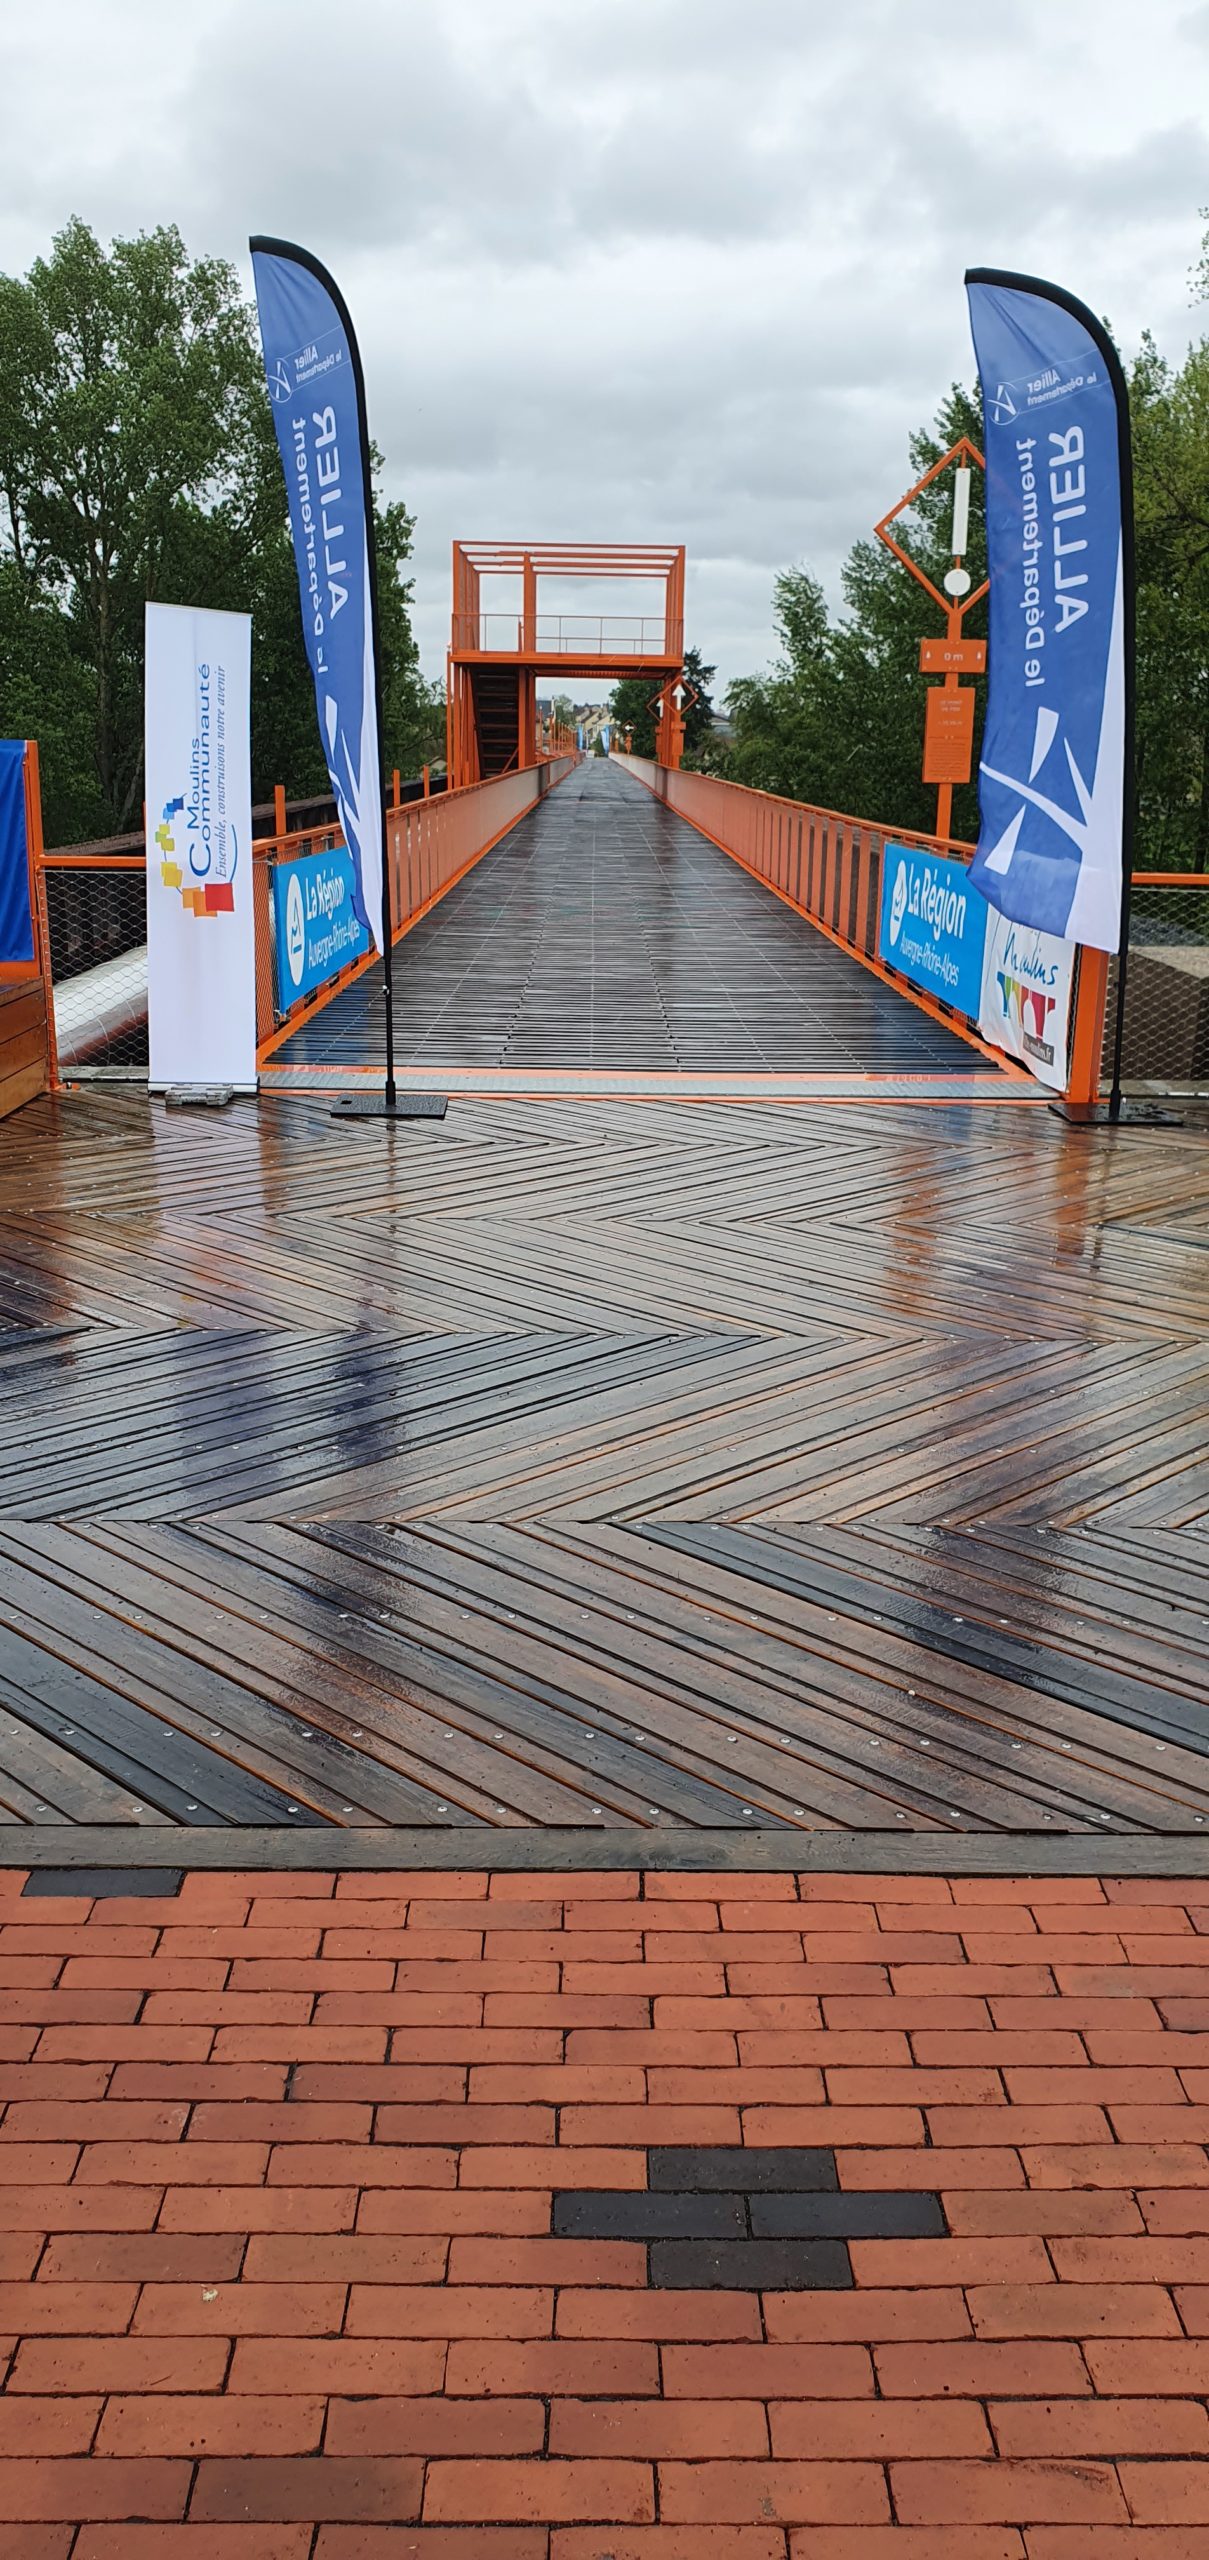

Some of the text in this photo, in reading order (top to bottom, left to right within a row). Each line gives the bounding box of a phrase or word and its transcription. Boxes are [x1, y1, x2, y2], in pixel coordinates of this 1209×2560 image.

[944, 652, 964, 661] 0 m
[187, 738, 200, 830] Moulins
[189, 664, 212, 877] Communauté
[215, 666, 227, 878] Ensemble, construisons notre avenir
[305, 868, 345, 921] La Région
[907, 863, 967, 942] La Région
[900, 930, 960, 987] Auvergne-Rhône-Alpes
